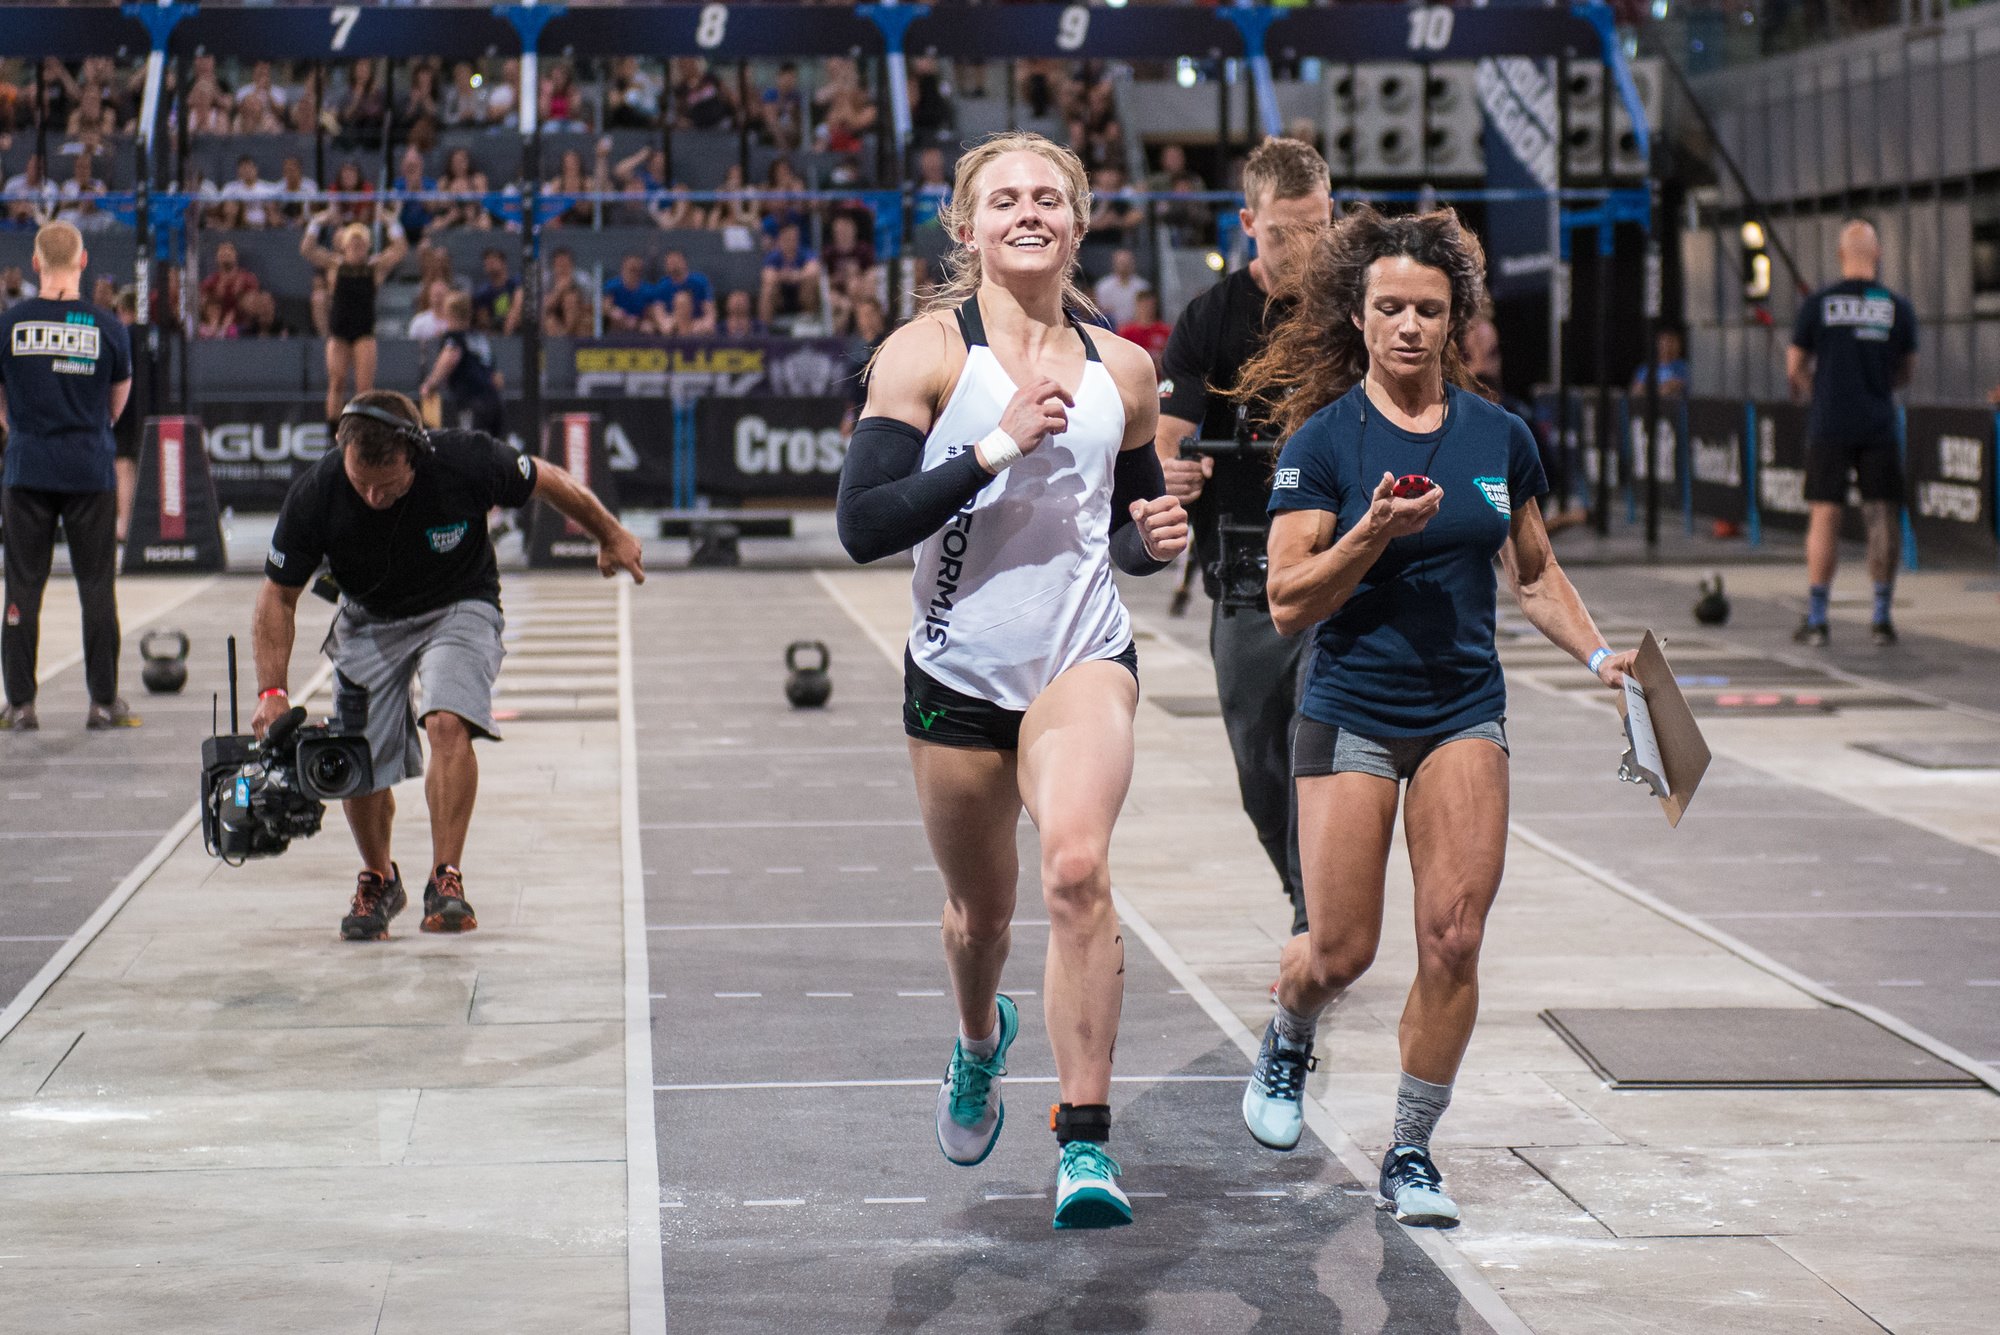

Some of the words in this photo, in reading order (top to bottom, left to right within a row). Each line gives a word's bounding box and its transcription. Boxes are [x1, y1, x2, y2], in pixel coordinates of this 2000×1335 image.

[331, 6, 360, 50] 7
[697, 4, 727, 49] 8
[1057, 6, 1089, 50] 9
[1409, 6, 1454, 50] 10
[15, 325, 97, 355] JUDGE
[203, 421, 332, 462] GUE
[734, 414, 850, 475] Cros
[1274, 470, 1298, 486] DGE
